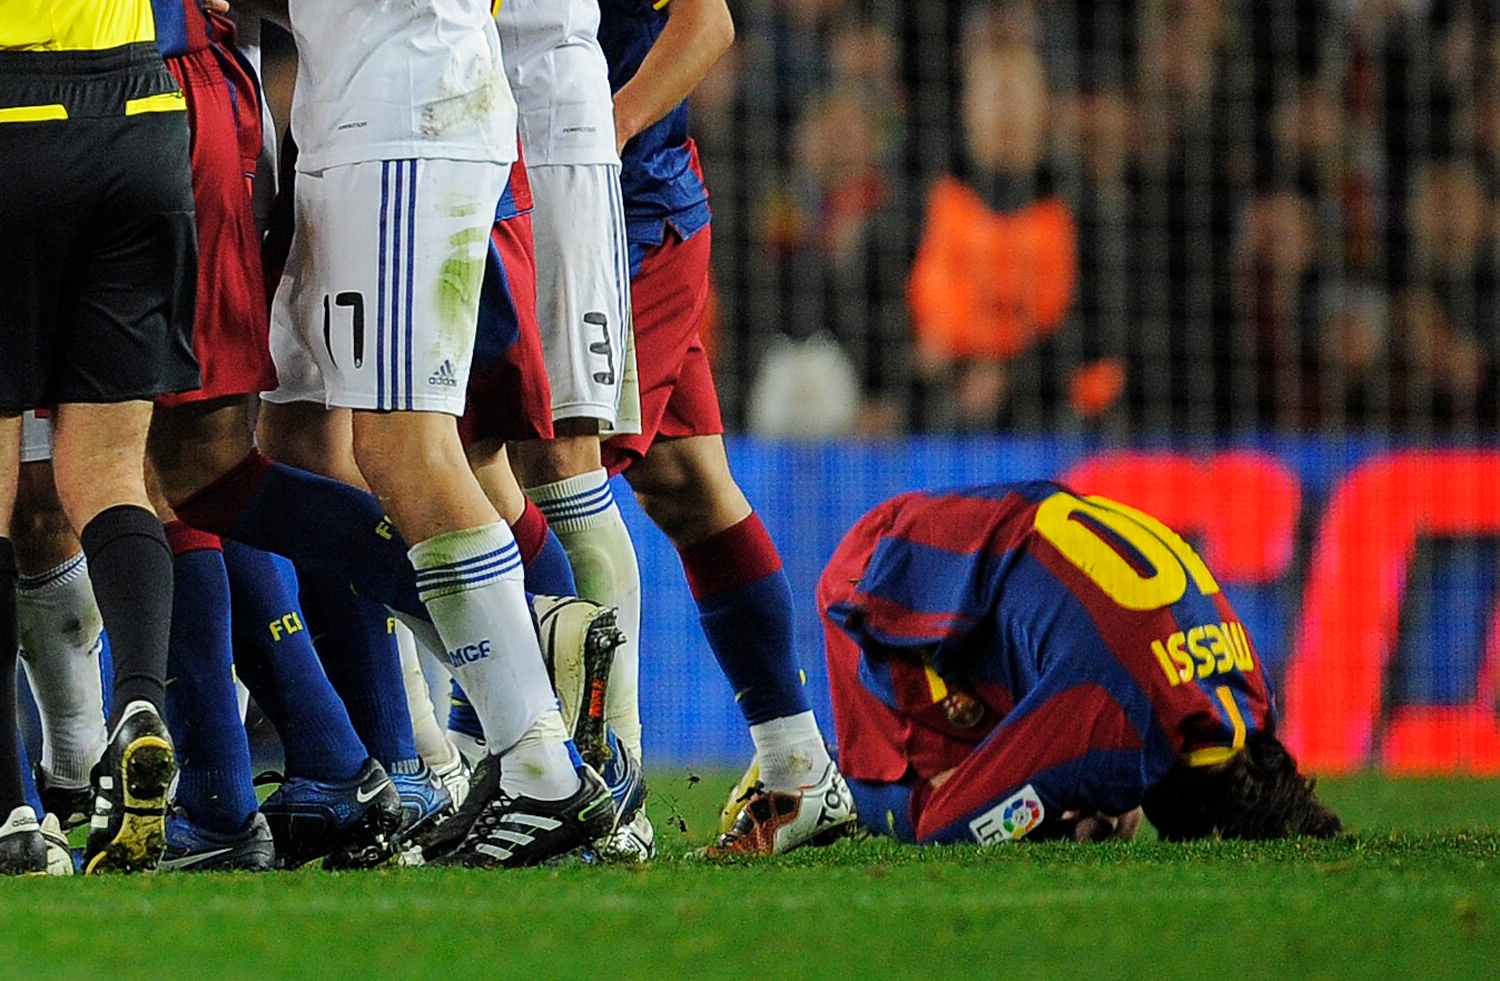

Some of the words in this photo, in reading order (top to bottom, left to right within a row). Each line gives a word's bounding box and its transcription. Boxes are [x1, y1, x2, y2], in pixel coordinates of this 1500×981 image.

[323, 292, 364, 368] 17
[1034, 491, 1220, 611] 10
[449, 640, 491, 668] MCF
[1151, 622, 1254, 687] MESSI
[976, 819, 1003, 841] LF
